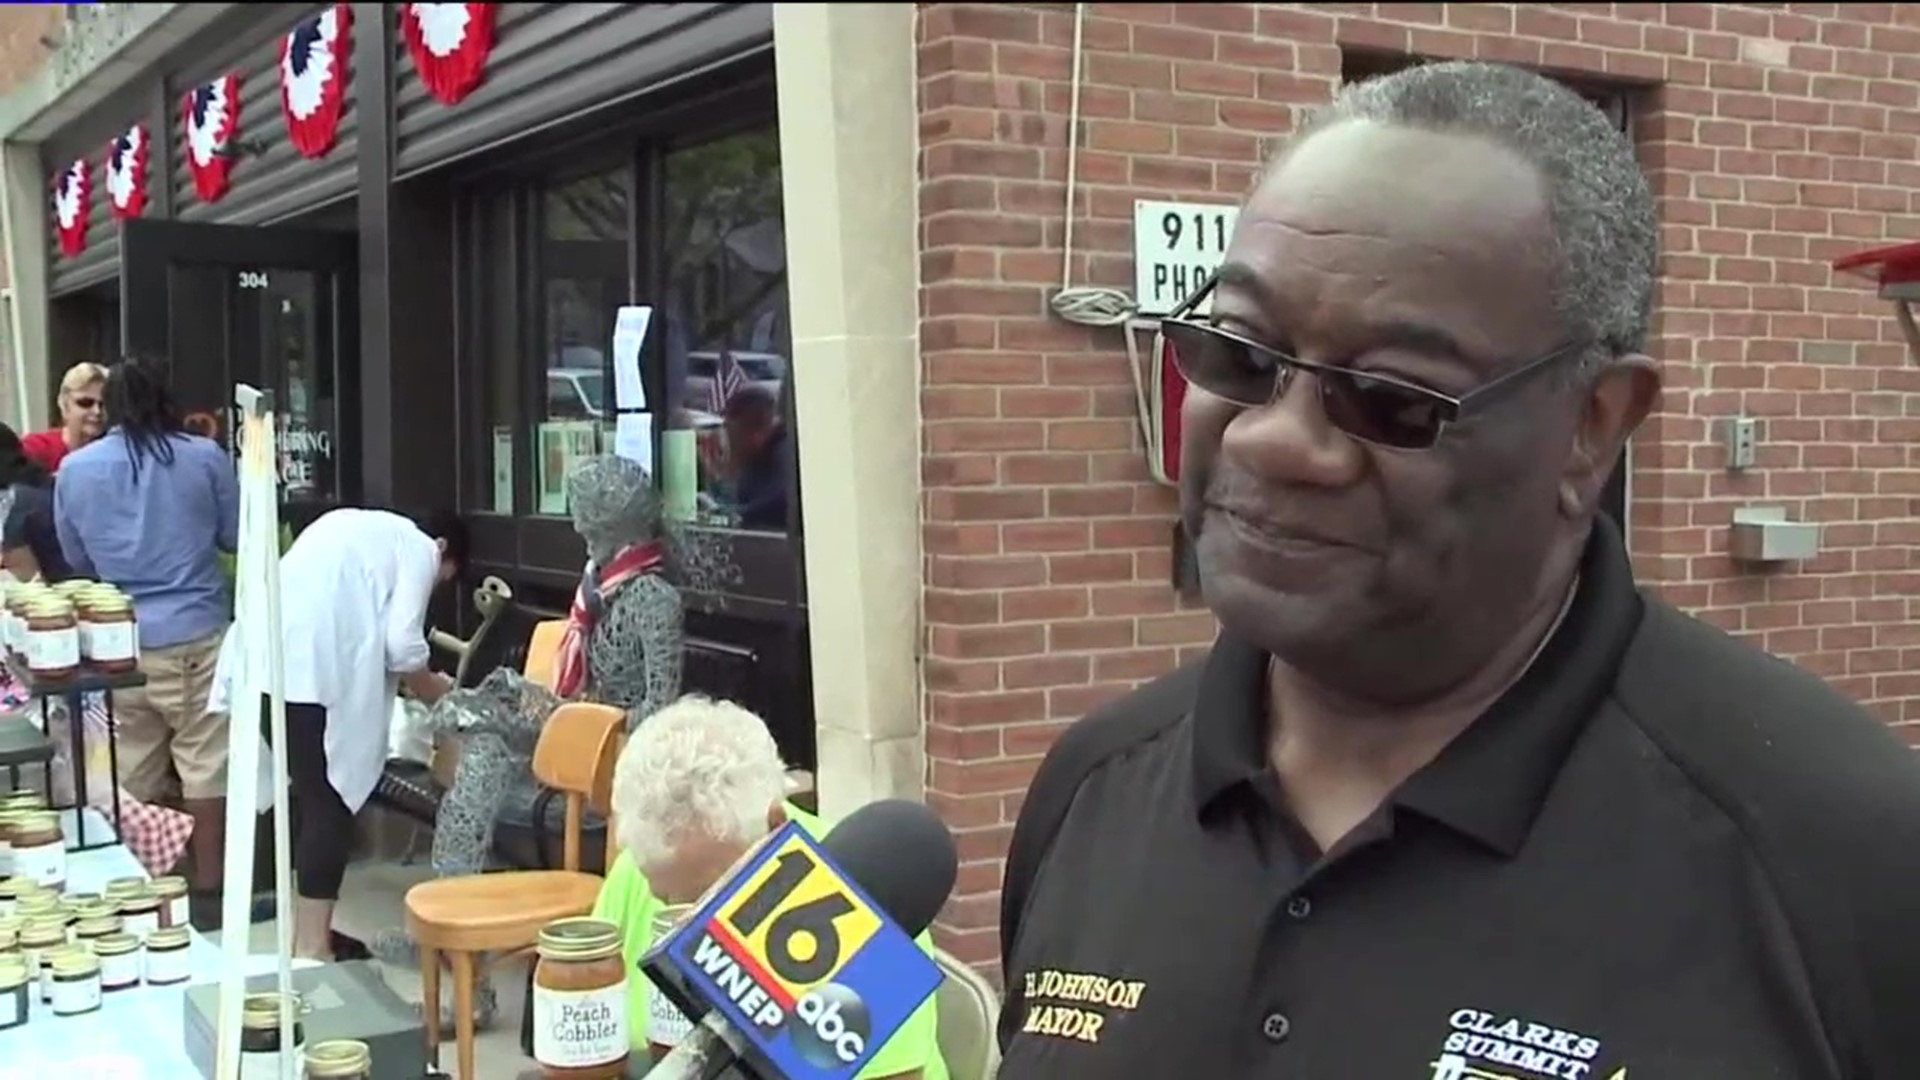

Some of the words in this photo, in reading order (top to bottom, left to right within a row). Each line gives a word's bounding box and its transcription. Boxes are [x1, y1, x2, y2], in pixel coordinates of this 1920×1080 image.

[1162, 212, 1225, 252] 911
[239, 271, 268, 288] 304
[1154, 262, 1216, 301] PHO
[729, 849, 857, 985] 16
[692, 935, 783, 1027] WNEP
[1037, 970, 1146, 1009] JOHNSON
[562, 1002, 610, 1022] Peach
[650, 999, 687, 1022] Cobb
[796, 992, 864, 1062] abc
[1023, 1005, 1104, 1042] MAYOR
[552, 1021, 618, 1042] Cobbler
[1449, 1008, 1600, 1060] CLARKS
[1444, 1031, 1589, 1080] SUMMIT
